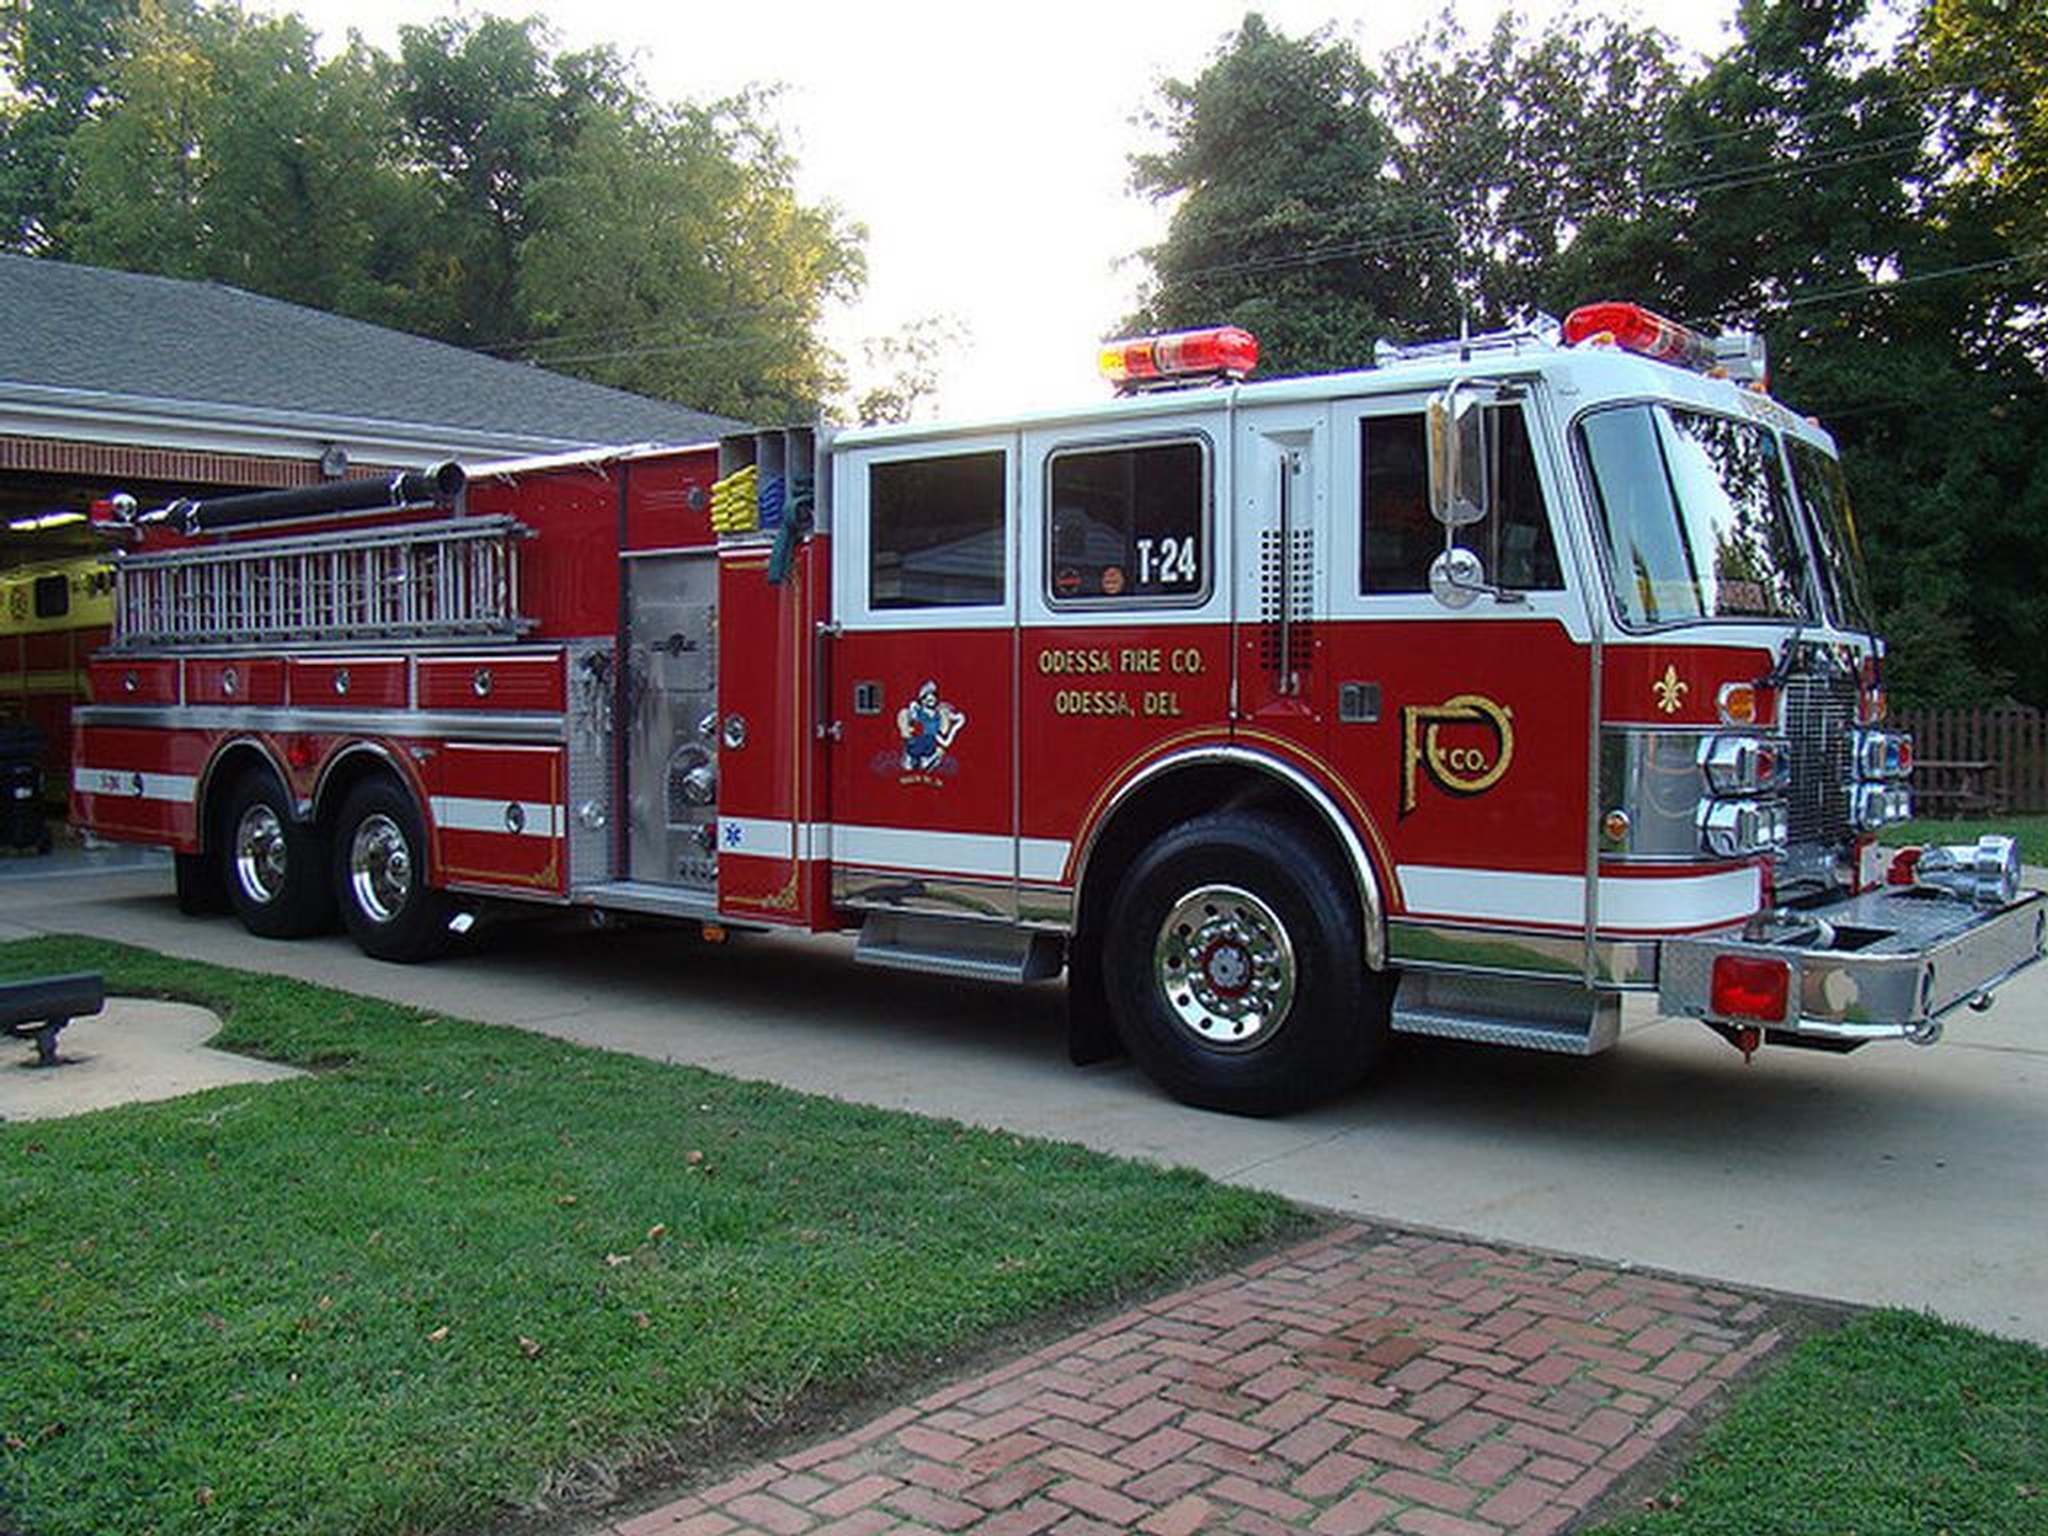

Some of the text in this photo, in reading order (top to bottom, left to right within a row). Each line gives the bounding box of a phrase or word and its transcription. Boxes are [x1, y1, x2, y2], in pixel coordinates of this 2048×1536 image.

[1136, 536, 1197, 584] T-24
[1039, 649, 1206, 673] ODESSA FIRE CO.
[1055, 690, 1135, 717] ODESSA,
